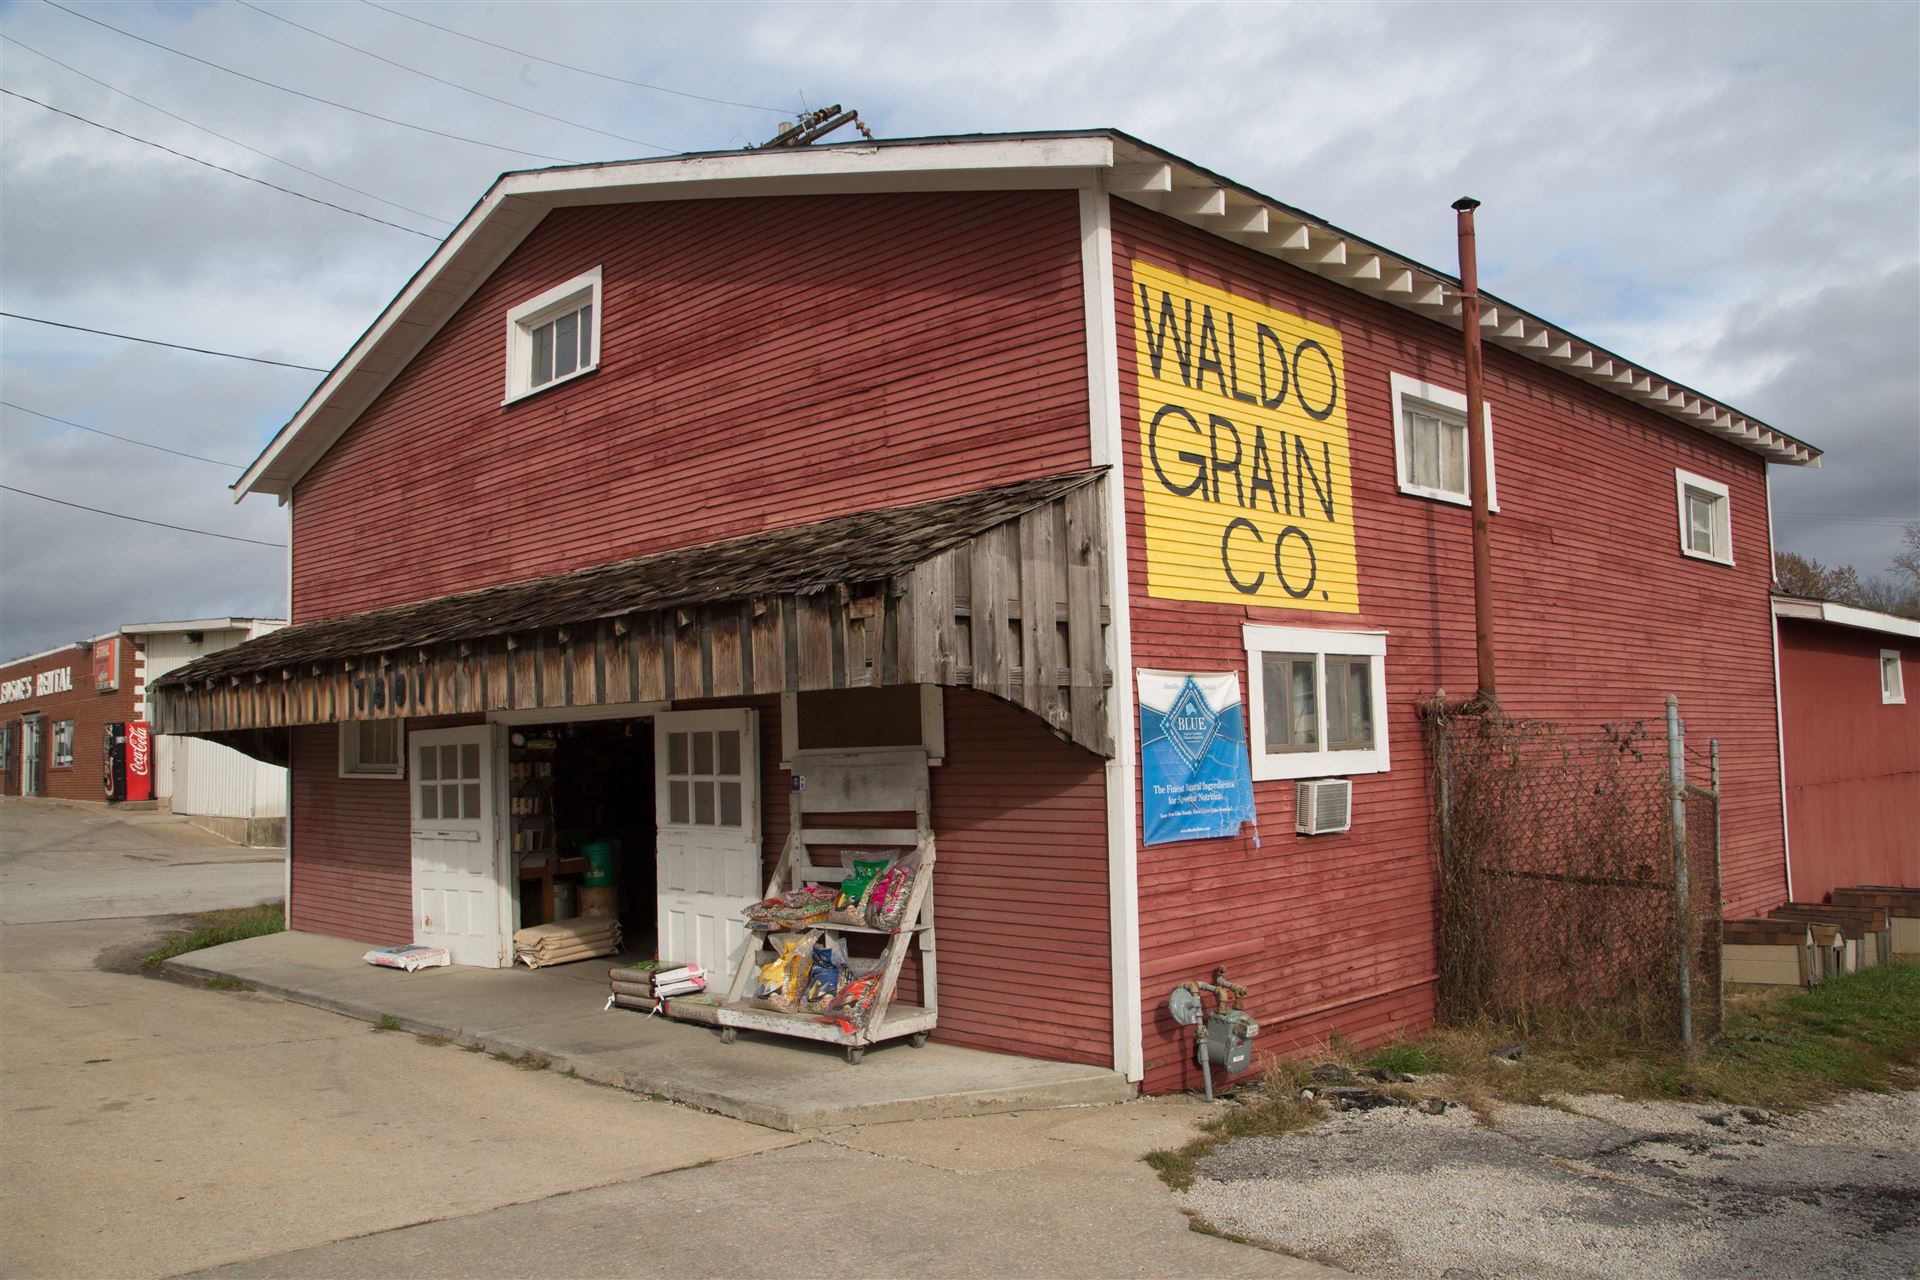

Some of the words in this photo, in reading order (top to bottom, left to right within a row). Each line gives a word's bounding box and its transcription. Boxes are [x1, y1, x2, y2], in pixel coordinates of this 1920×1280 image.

[1139, 284, 1337, 421] WALDO
[1149, 404, 1335, 523] GRAIN
[1221, 517, 1329, 602] CO.
[36, 666, 73, 697] RENTAL
[1178, 717, 1206, 731] BLUE
[1153, 785, 1166, 795] The
[1166, 784, 1185, 793] Finest
[1168, 795, 1177, 805] for
